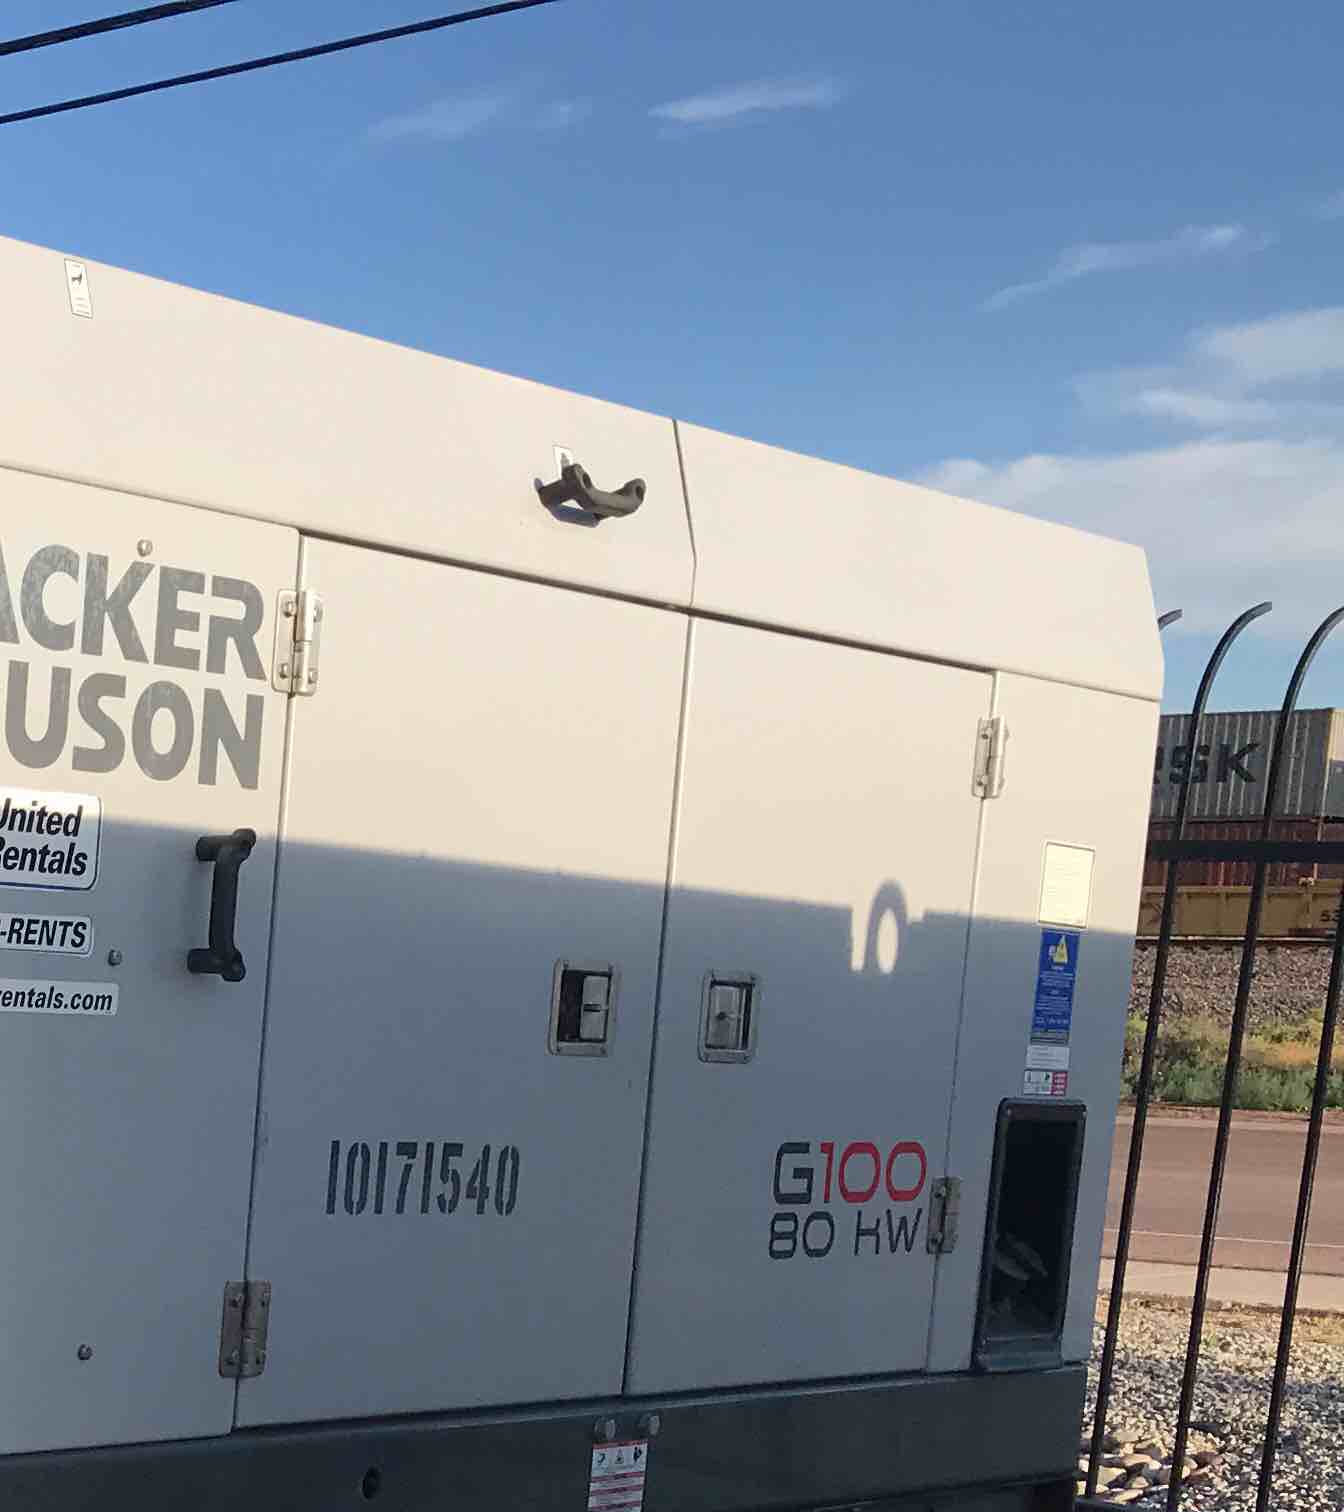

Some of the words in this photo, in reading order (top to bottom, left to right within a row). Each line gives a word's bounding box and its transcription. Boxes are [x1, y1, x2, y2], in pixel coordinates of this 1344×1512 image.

[325, 1139, 521, 1217] 10171540
[772, 1140, 928, 1206] G100
[768, 1210, 836, 1260] 80
